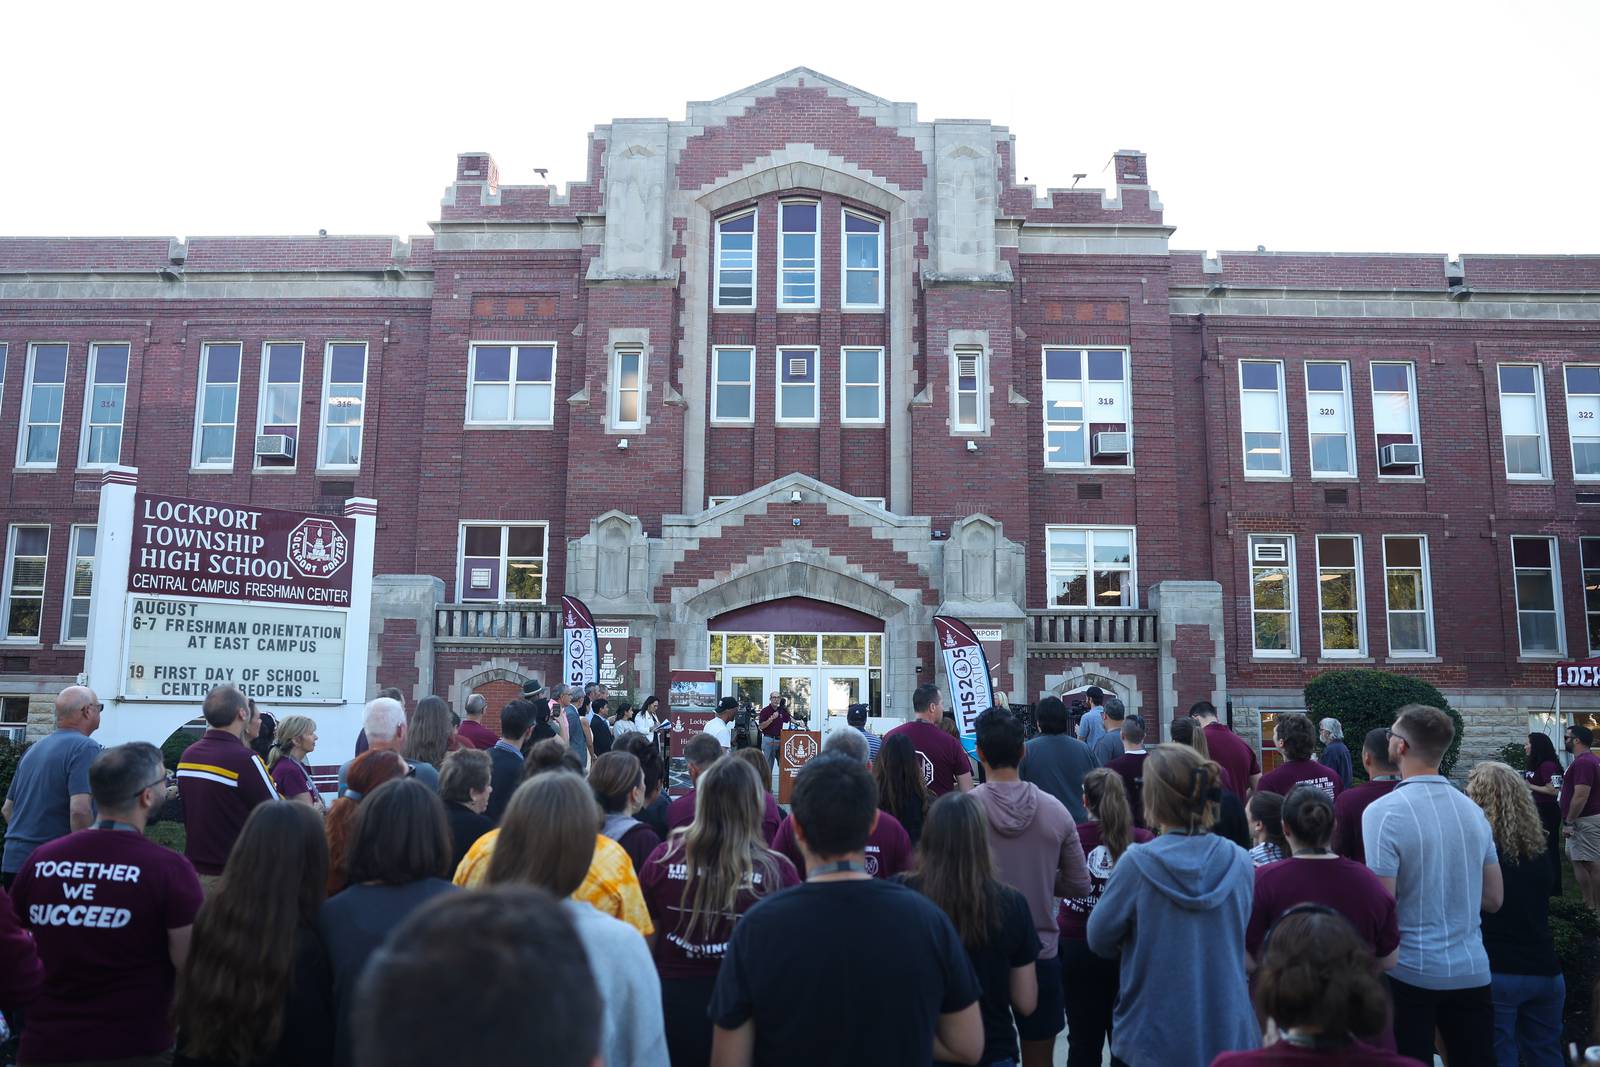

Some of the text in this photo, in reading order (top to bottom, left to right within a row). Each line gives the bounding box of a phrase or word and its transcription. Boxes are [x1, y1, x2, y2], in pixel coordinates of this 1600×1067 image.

[1098, 397, 1114, 405] 318
[1319, 408, 1335, 416] 320
[1578, 411, 1594, 419] 322
[144, 500, 262, 531] LOCKPORT
[142, 524, 265, 554] TOWNSHIP
[292, 531, 344, 573] LOCKPORT PORTERS
[140, 548, 294, 580] HIGH SCHOOL
[132, 573, 348, 603] CENTRAL CAMPUS FRESHMAN CENTER
[133, 600, 198, 617] AUGUST
[132, 616, 341, 639] 6-7 FRESHMAN ORIENTATION
[187, 635, 317, 653] AT EAST CAMPUS
[129, 665, 320, 683] 19 FIRST DAY OF SCHOOL
[161, 682, 303, 697] CENTR REOPENS
[34, 860, 141, 883] TOGETHER
[62, 881, 97, 900] WE
[29, 904, 132, 929] SUCCEED
